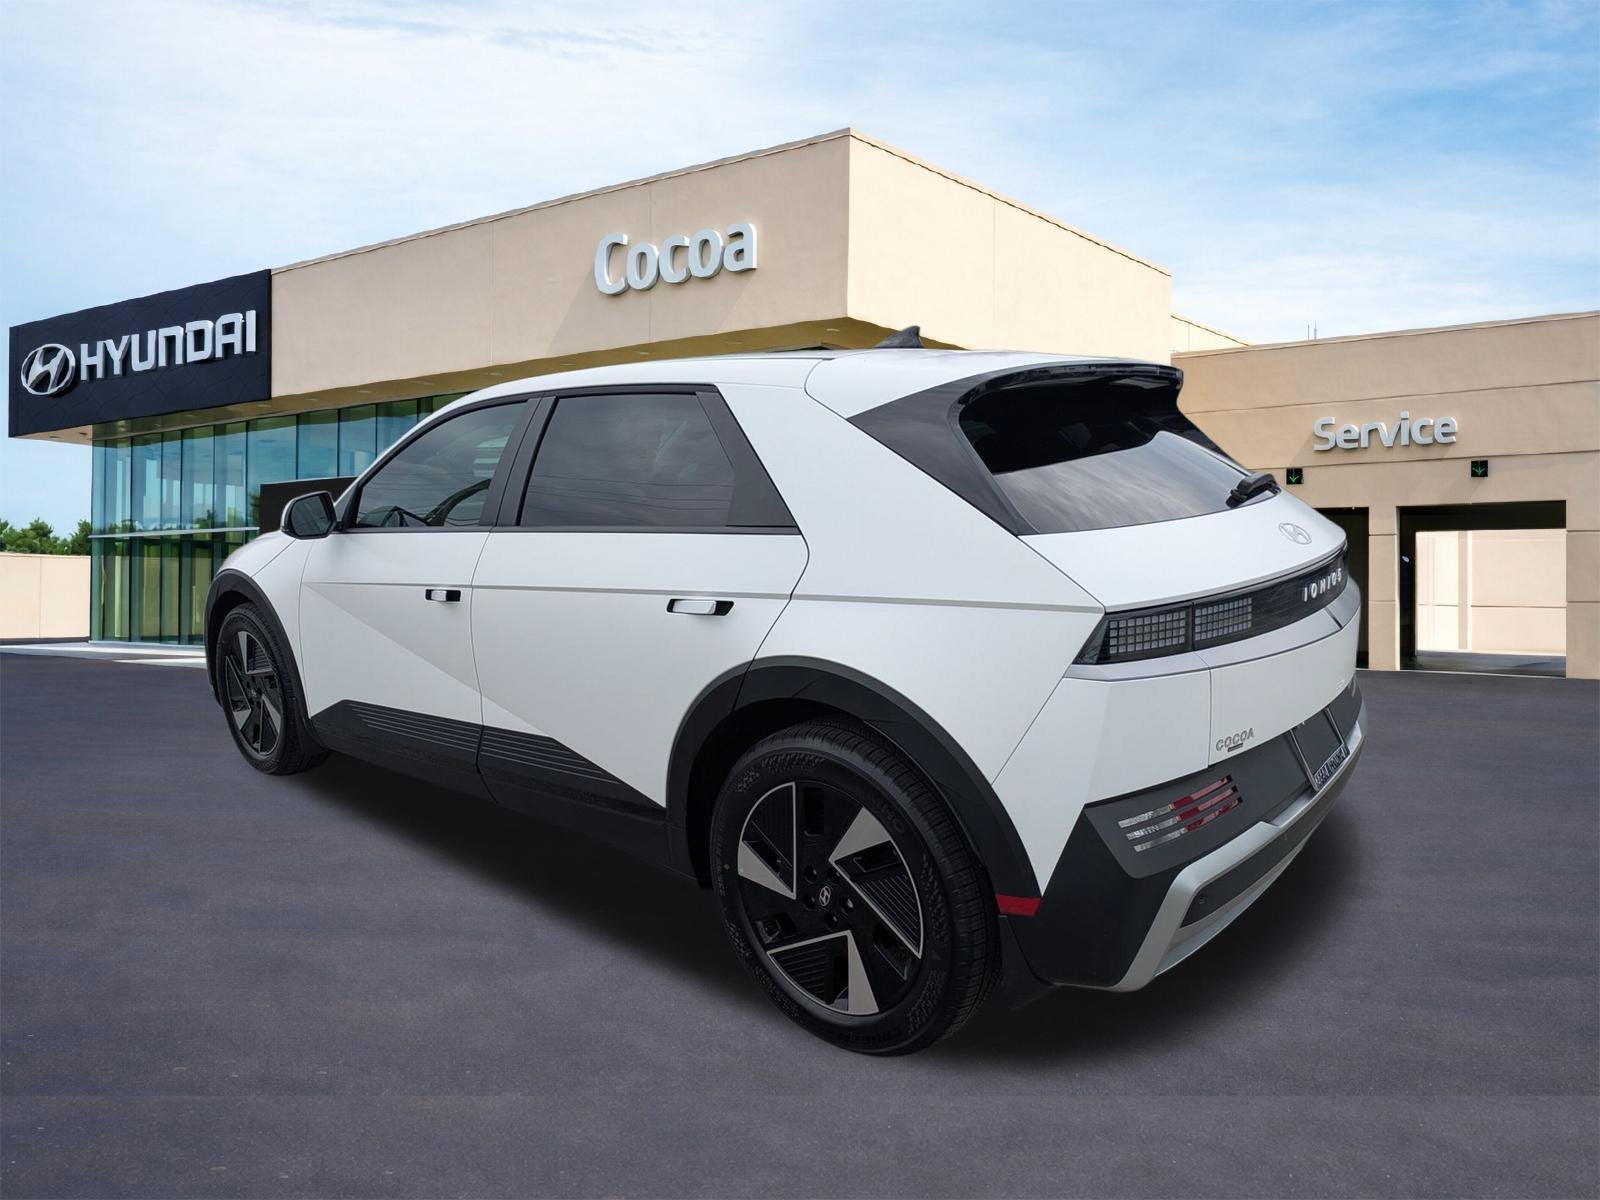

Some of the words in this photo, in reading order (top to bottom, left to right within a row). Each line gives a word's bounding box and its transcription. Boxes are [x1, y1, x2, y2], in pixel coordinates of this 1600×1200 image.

[594, 222, 758, 295] Cocoa
[80, 309, 257, 381] HYUNDAI
[1312, 410, 1458, 451] Service
[1215, 727, 1254, 751] COCOA
